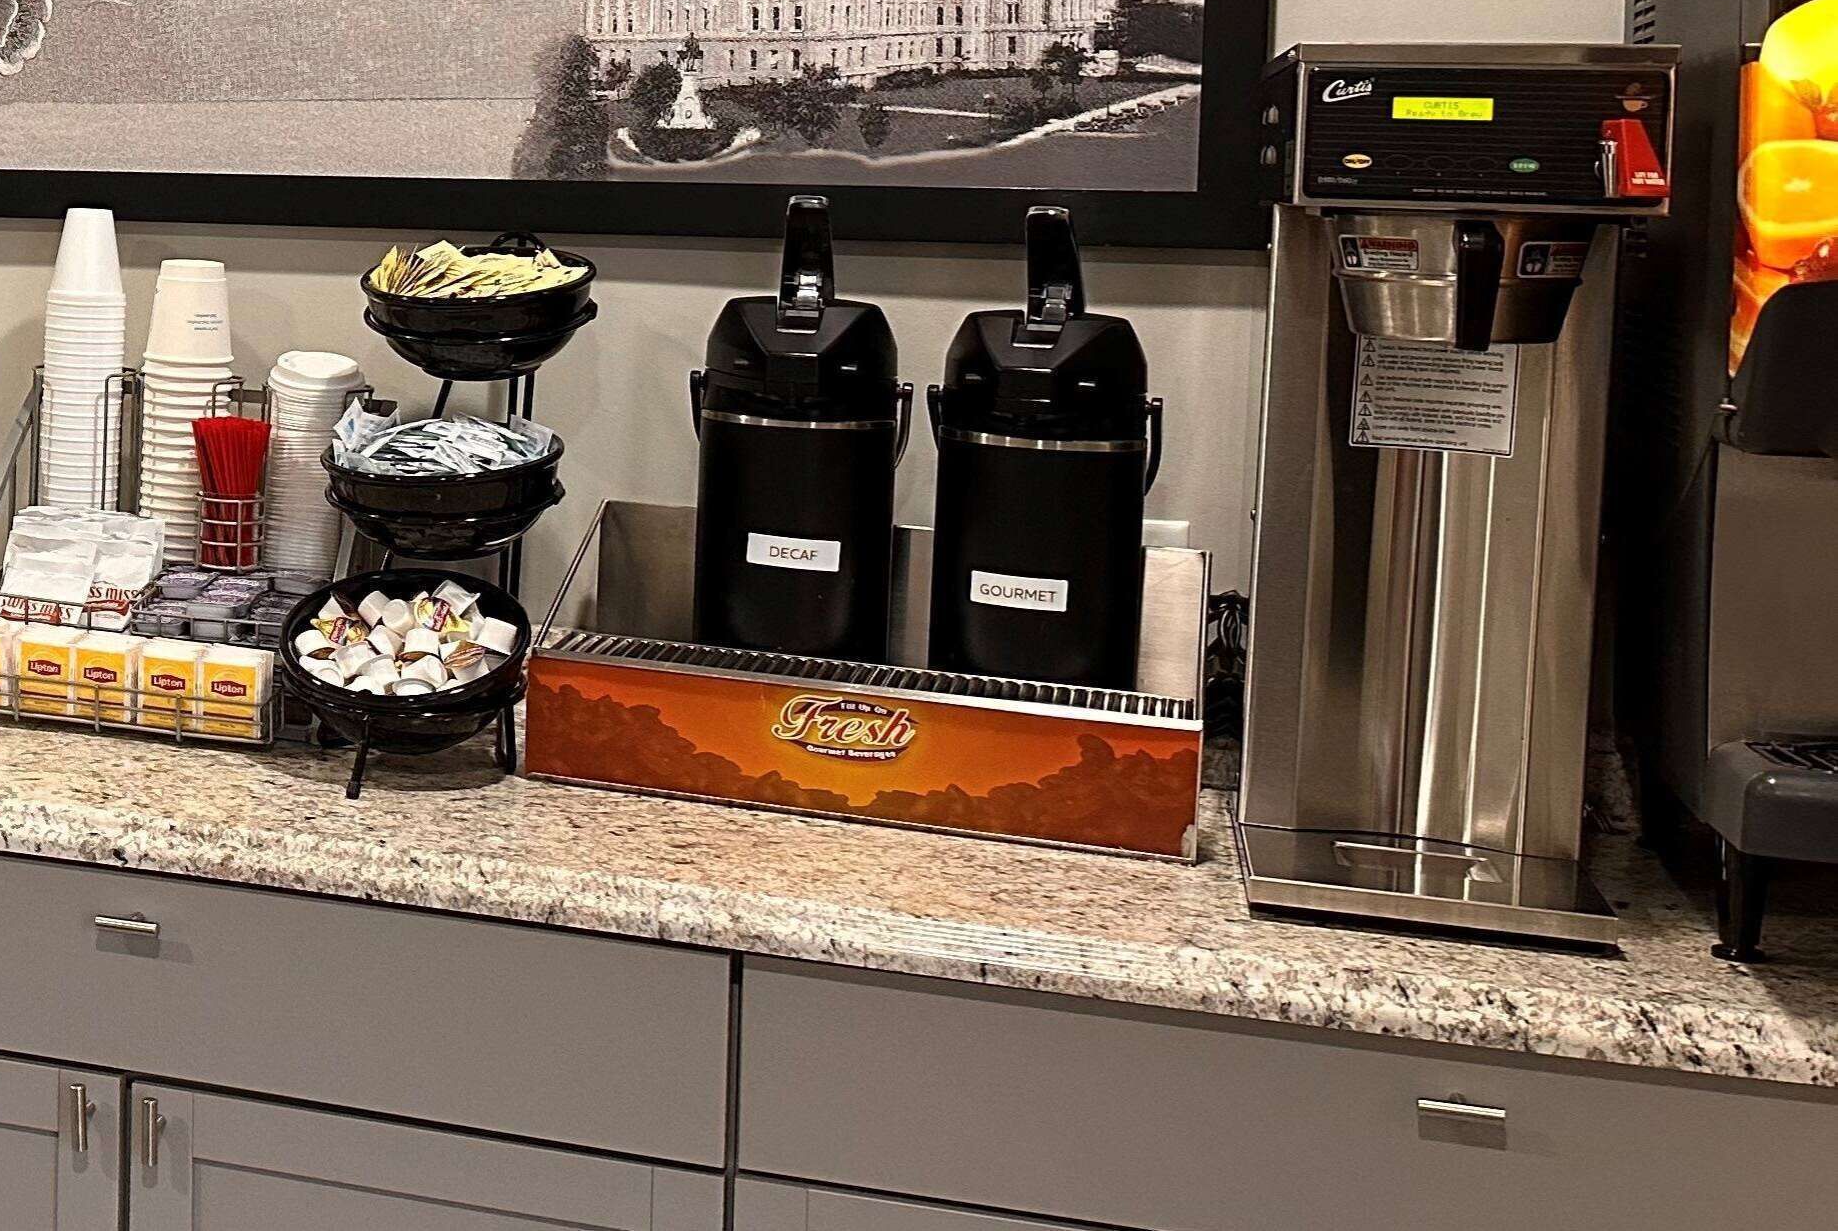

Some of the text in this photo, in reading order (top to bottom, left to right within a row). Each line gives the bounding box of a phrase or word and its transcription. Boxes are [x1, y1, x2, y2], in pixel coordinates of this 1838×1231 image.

[1322, 78, 1373, 103] Curtis
[769, 545, 818, 561] DECAF
[979, 583, 1057, 603] GOURMET
[30, 661, 59, 674] Lipton
[85, 669, 115, 682] Lipton
[153, 676, 183, 688] Lipton
[213, 683, 244, 694] Lipton
[771, 694, 917, 746] Fresh
